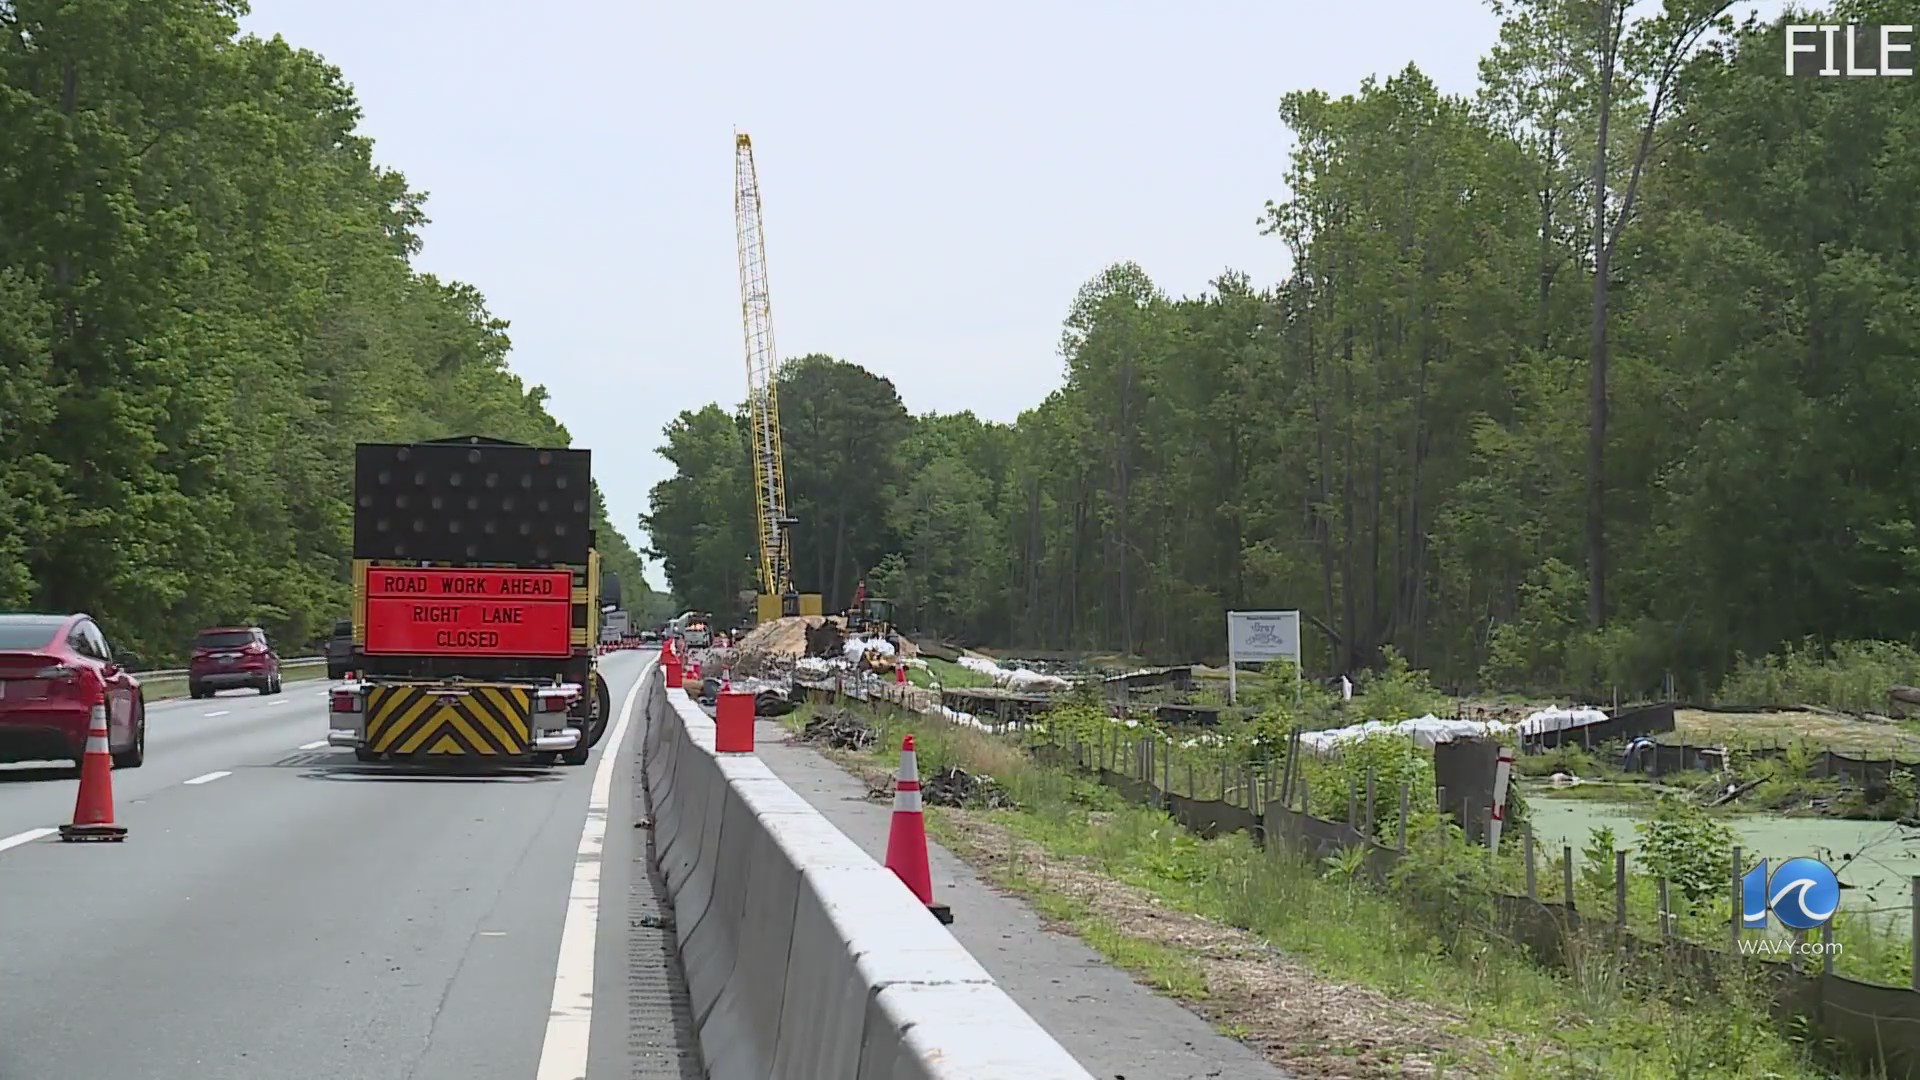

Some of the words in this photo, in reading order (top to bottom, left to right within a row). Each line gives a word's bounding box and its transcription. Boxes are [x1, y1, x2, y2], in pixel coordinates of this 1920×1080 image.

[384, 576, 427, 593] ROAD
[442, 577, 486, 594] WORK
[500, 578, 552, 595] AHEAD
[413, 606, 460, 623] RIGHT
[482, 607, 523, 624] LANE
[436, 630, 499, 648] CLOSED
